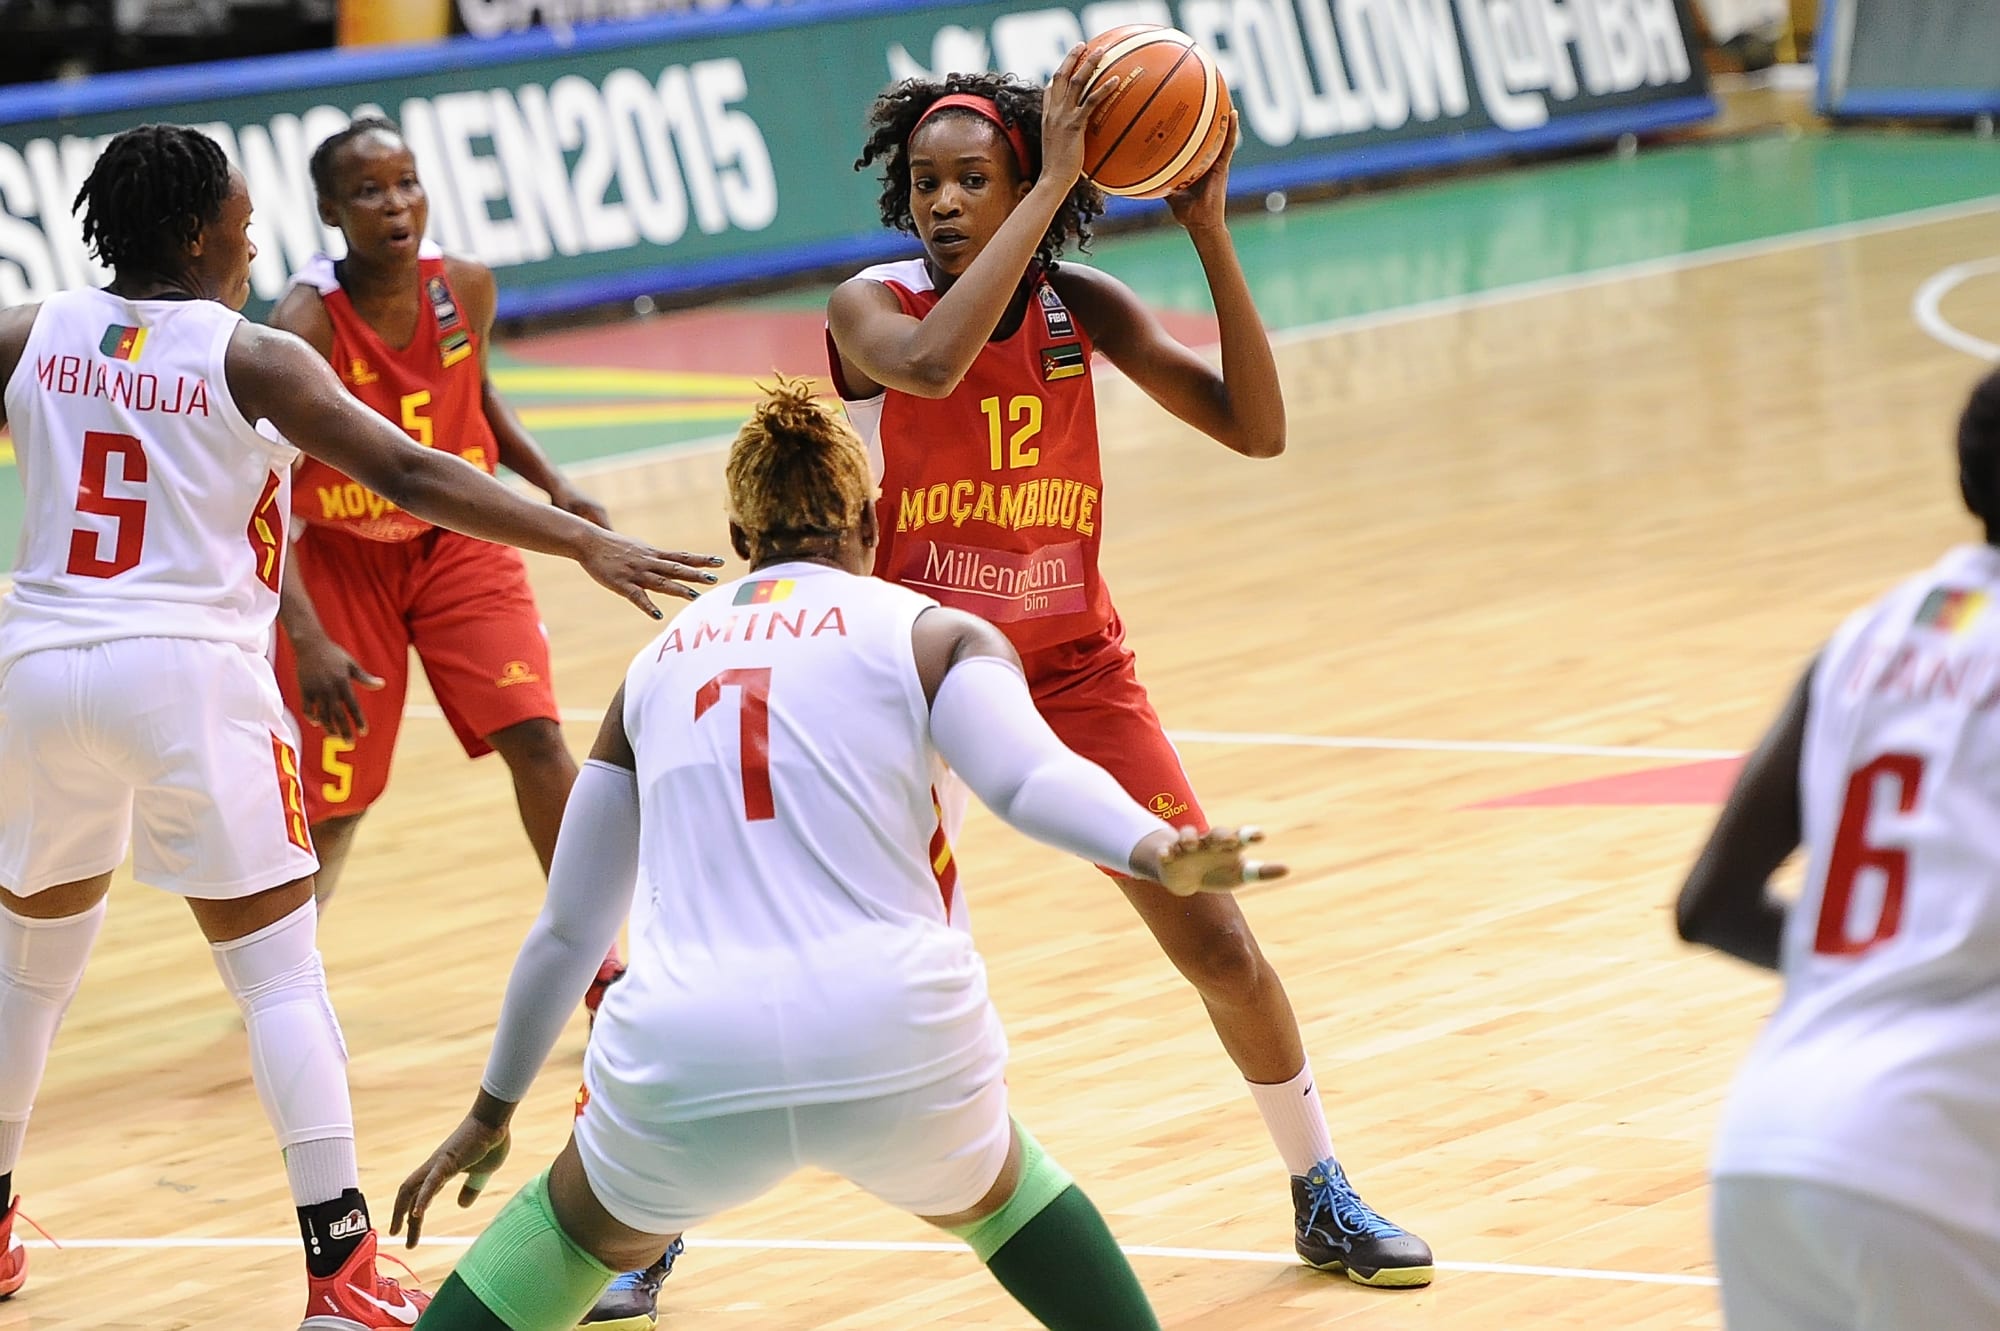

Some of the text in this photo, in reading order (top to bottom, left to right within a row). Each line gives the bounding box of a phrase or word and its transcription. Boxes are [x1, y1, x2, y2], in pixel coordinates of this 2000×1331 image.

[1047, 311, 1068, 324] FIBA
[37, 354, 209, 417] MBIANDJA
[400, 389, 435, 448] 5
[980, 394, 1044, 471] 12
[896, 478, 1099, 537] MOÇAMBIQUE
[922, 540, 1068, 594] Millennium
[1024, 592, 1050, 612] bim
[656, 606, 848, 664] AMINA
[321, 736, 356, 803] 5
[694, 667, 776, 822] 7
[1812, 752, 1927, 957] 6
